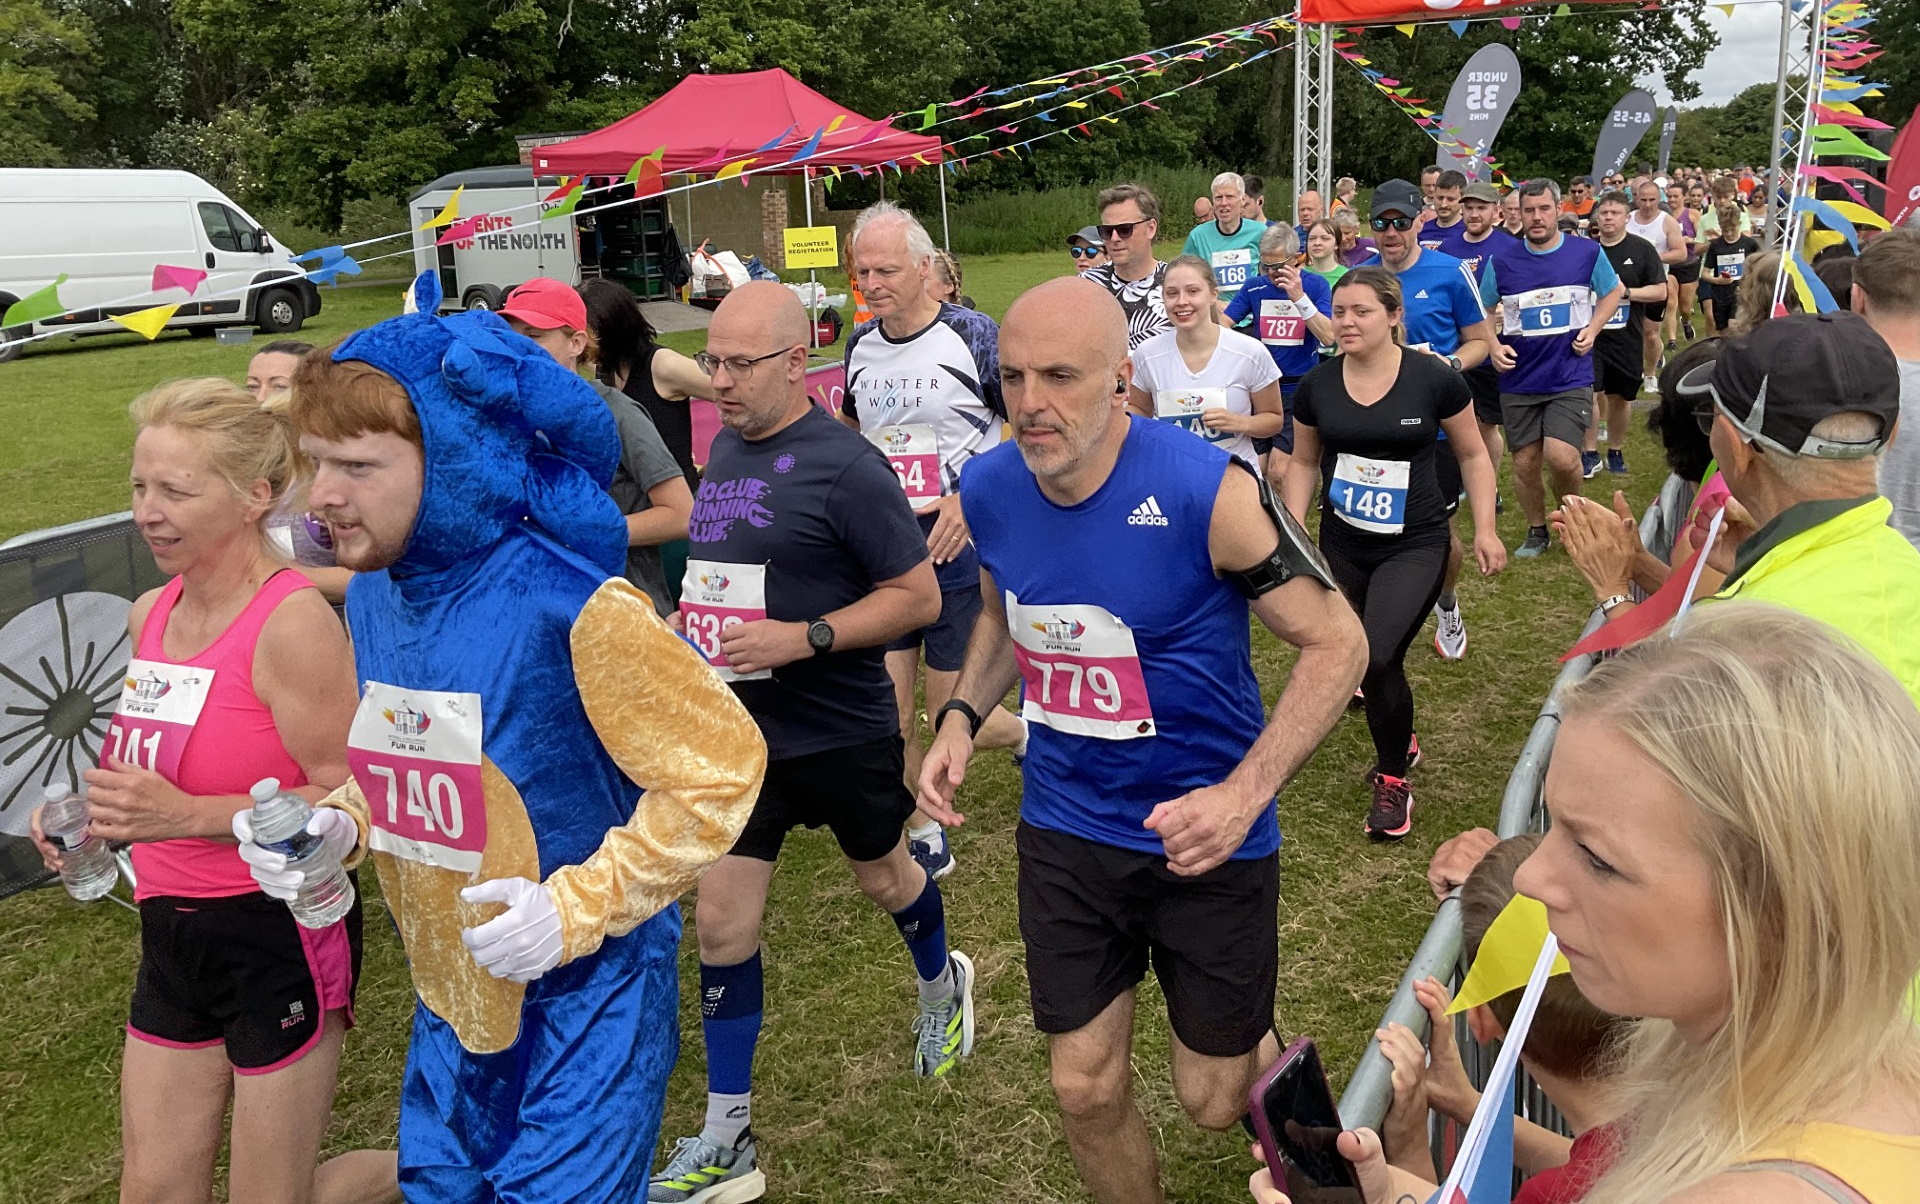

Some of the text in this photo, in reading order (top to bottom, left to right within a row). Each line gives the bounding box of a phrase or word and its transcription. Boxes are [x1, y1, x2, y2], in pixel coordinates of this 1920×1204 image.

[477, 235, 508, 250] THE
[511, 233, 566, 250] NORTH
[792, 240, 829, 248] VOLUNTEER
[1219, 267, 1247, 284] 168
[1540, 308, 1552, 327] 6
[1266, 320, 1298, 337] 787
[860, 379, 939, 390] WINTER
[869, 397, 922, 408] WOLF
[1343, 486, 1393, 519] 148
[1127, 514, 1168, 526] adidas
[1027, 657, 1122, 713] 779
[126, 704, 156, 714] FUN RUN
[110, 724, 163, 771] 741
[391, 741, 425, 752] FUN RUN
[367, 763, 464, 839] 740
[281, 1014, 305, 1030] RUN
